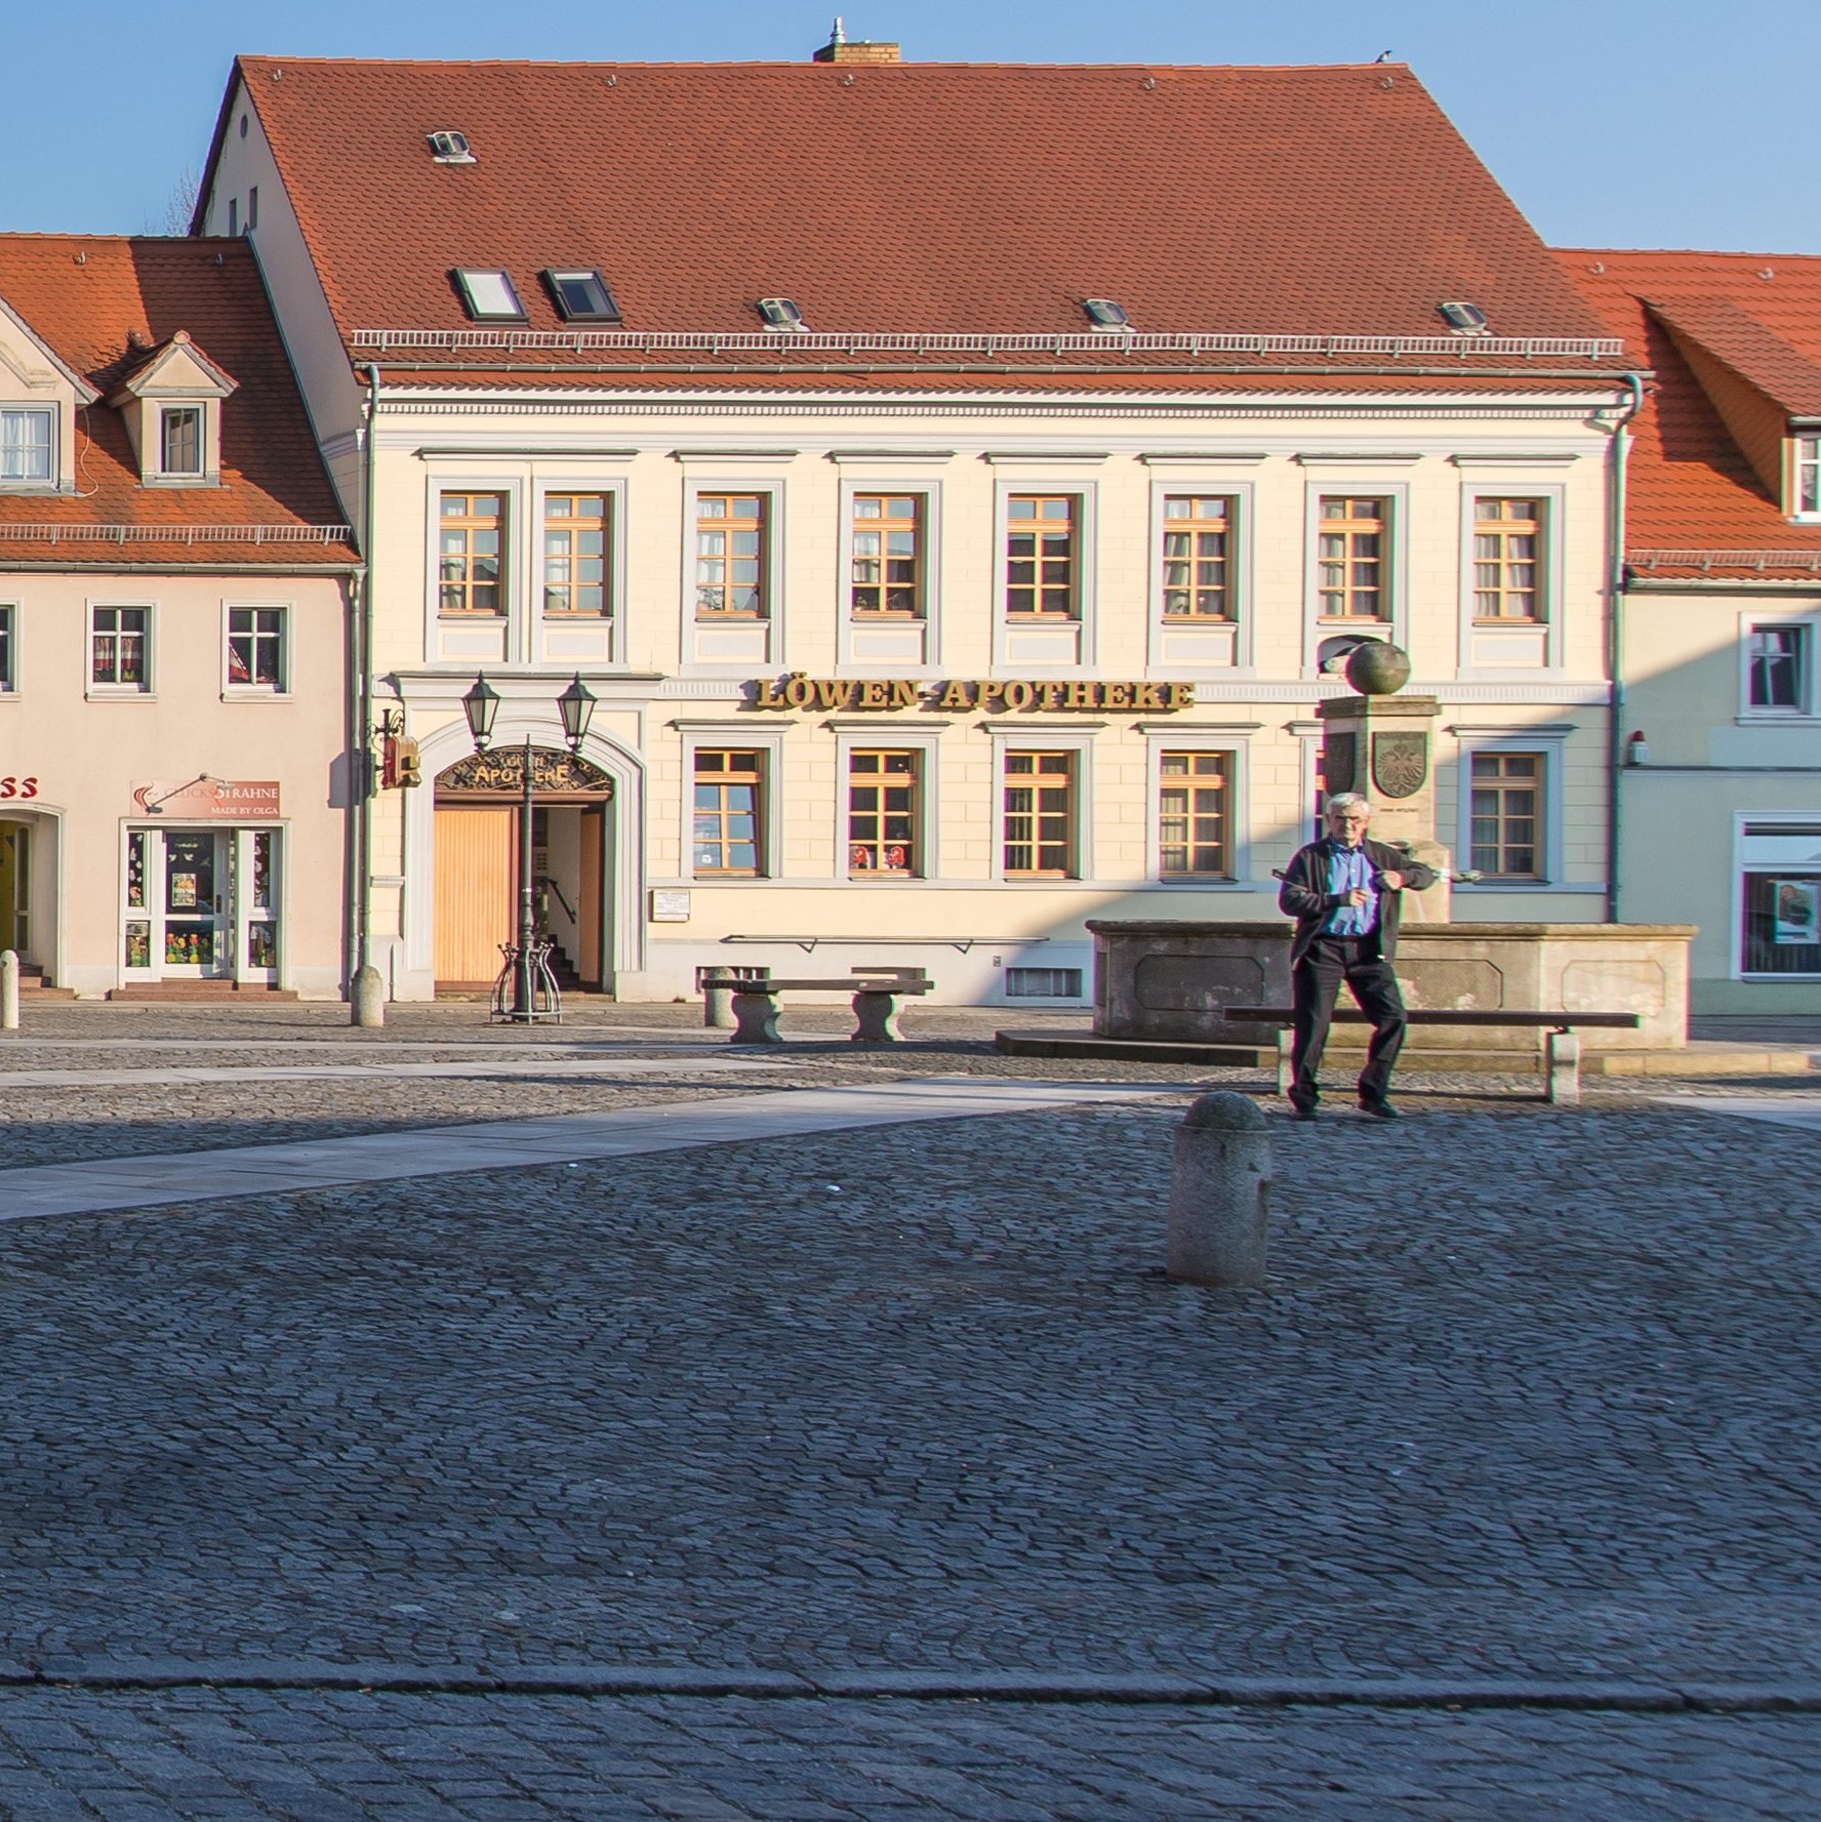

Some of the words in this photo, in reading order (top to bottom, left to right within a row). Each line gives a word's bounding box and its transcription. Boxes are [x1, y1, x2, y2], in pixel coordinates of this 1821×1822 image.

[474, 765, 570, 784] APOTEKE
[211, 806, 237, 815] MADE
[239, 806, 251, 815] BY
[252, 806, 278, 815] OLGA
